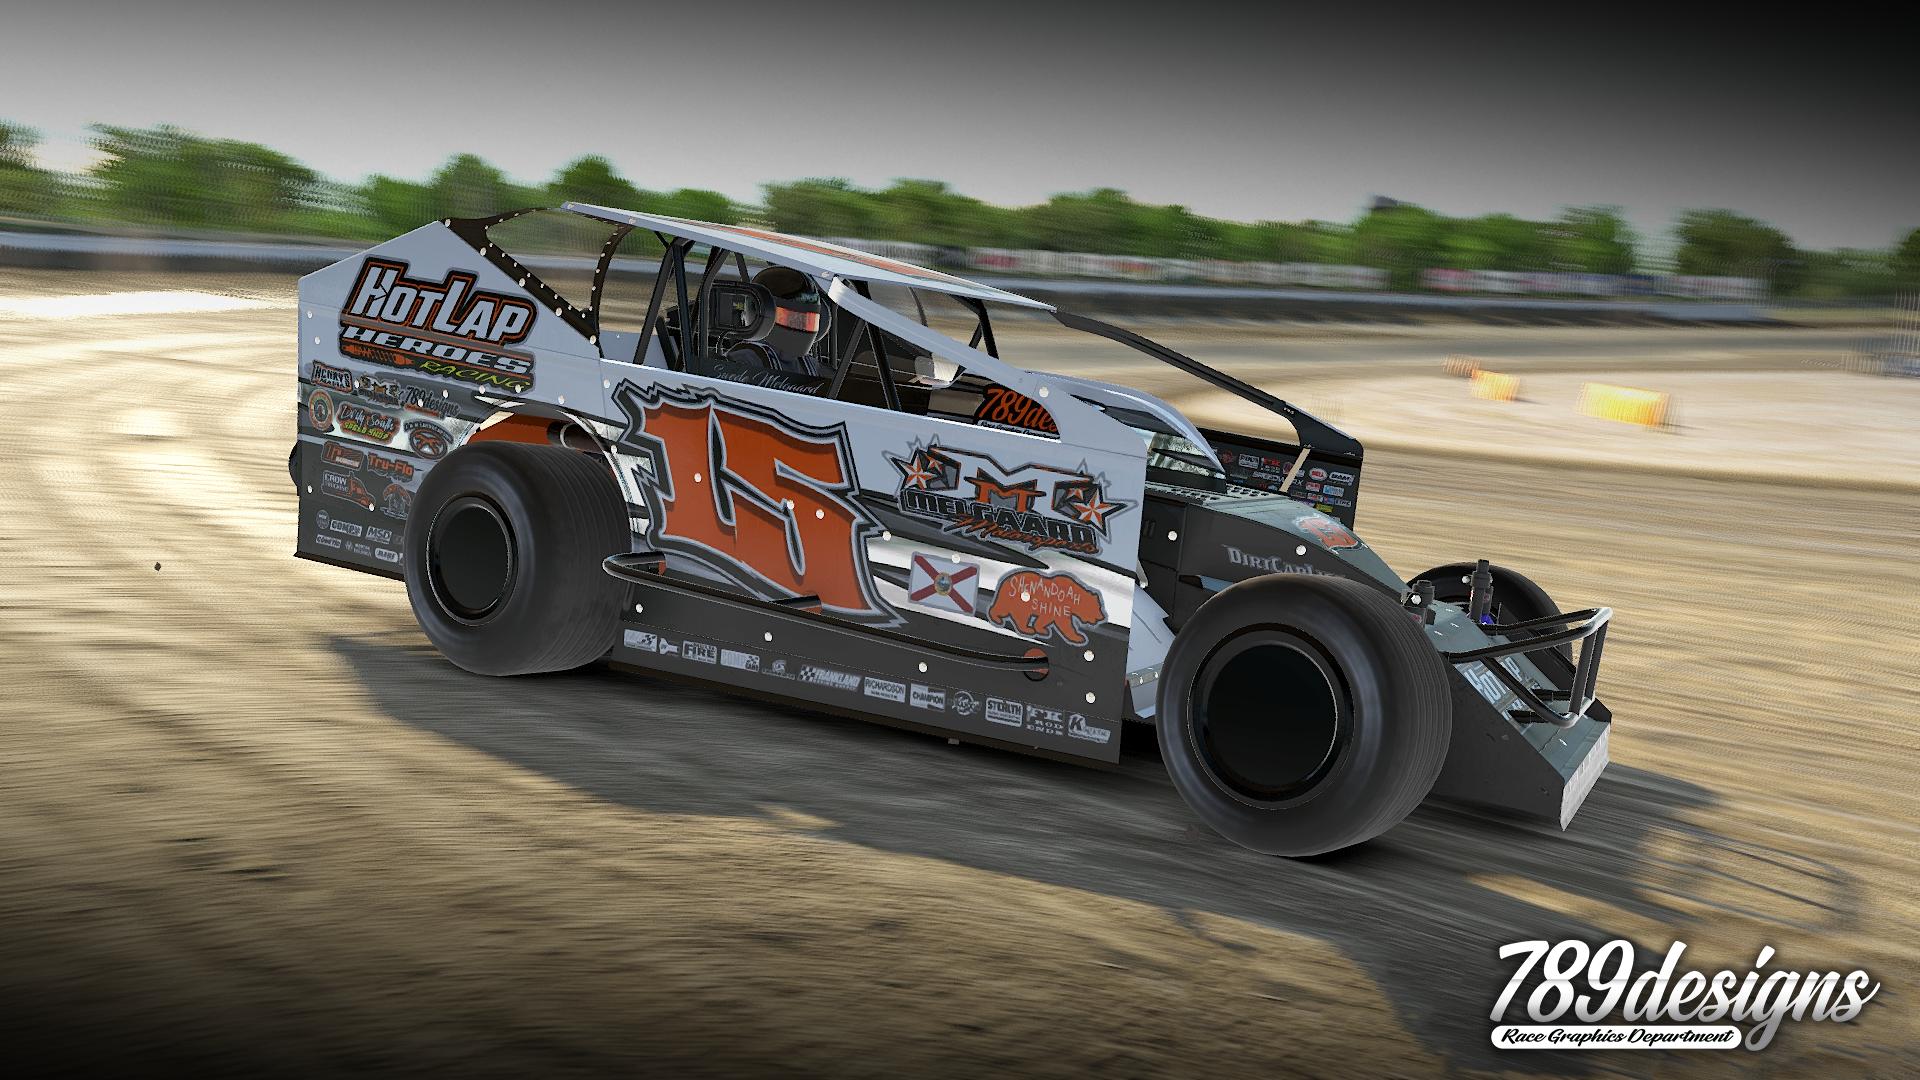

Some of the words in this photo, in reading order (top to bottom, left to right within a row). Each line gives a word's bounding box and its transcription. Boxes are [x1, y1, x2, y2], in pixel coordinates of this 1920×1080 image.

[342, 326, 532, 375] HEROES
[419, 359, 531, 389] RACING
[368, 454, 414, 475] Tru-Flo
[640, 398, 884, 612] 15
[904, 490, 1098, 547] MELGAARD
[1008, 576, 1081, 605] SHENANDOAH
[1032, 598, 1071, 617] SHINE
[912, 691, 944, 704] CHAMPION
